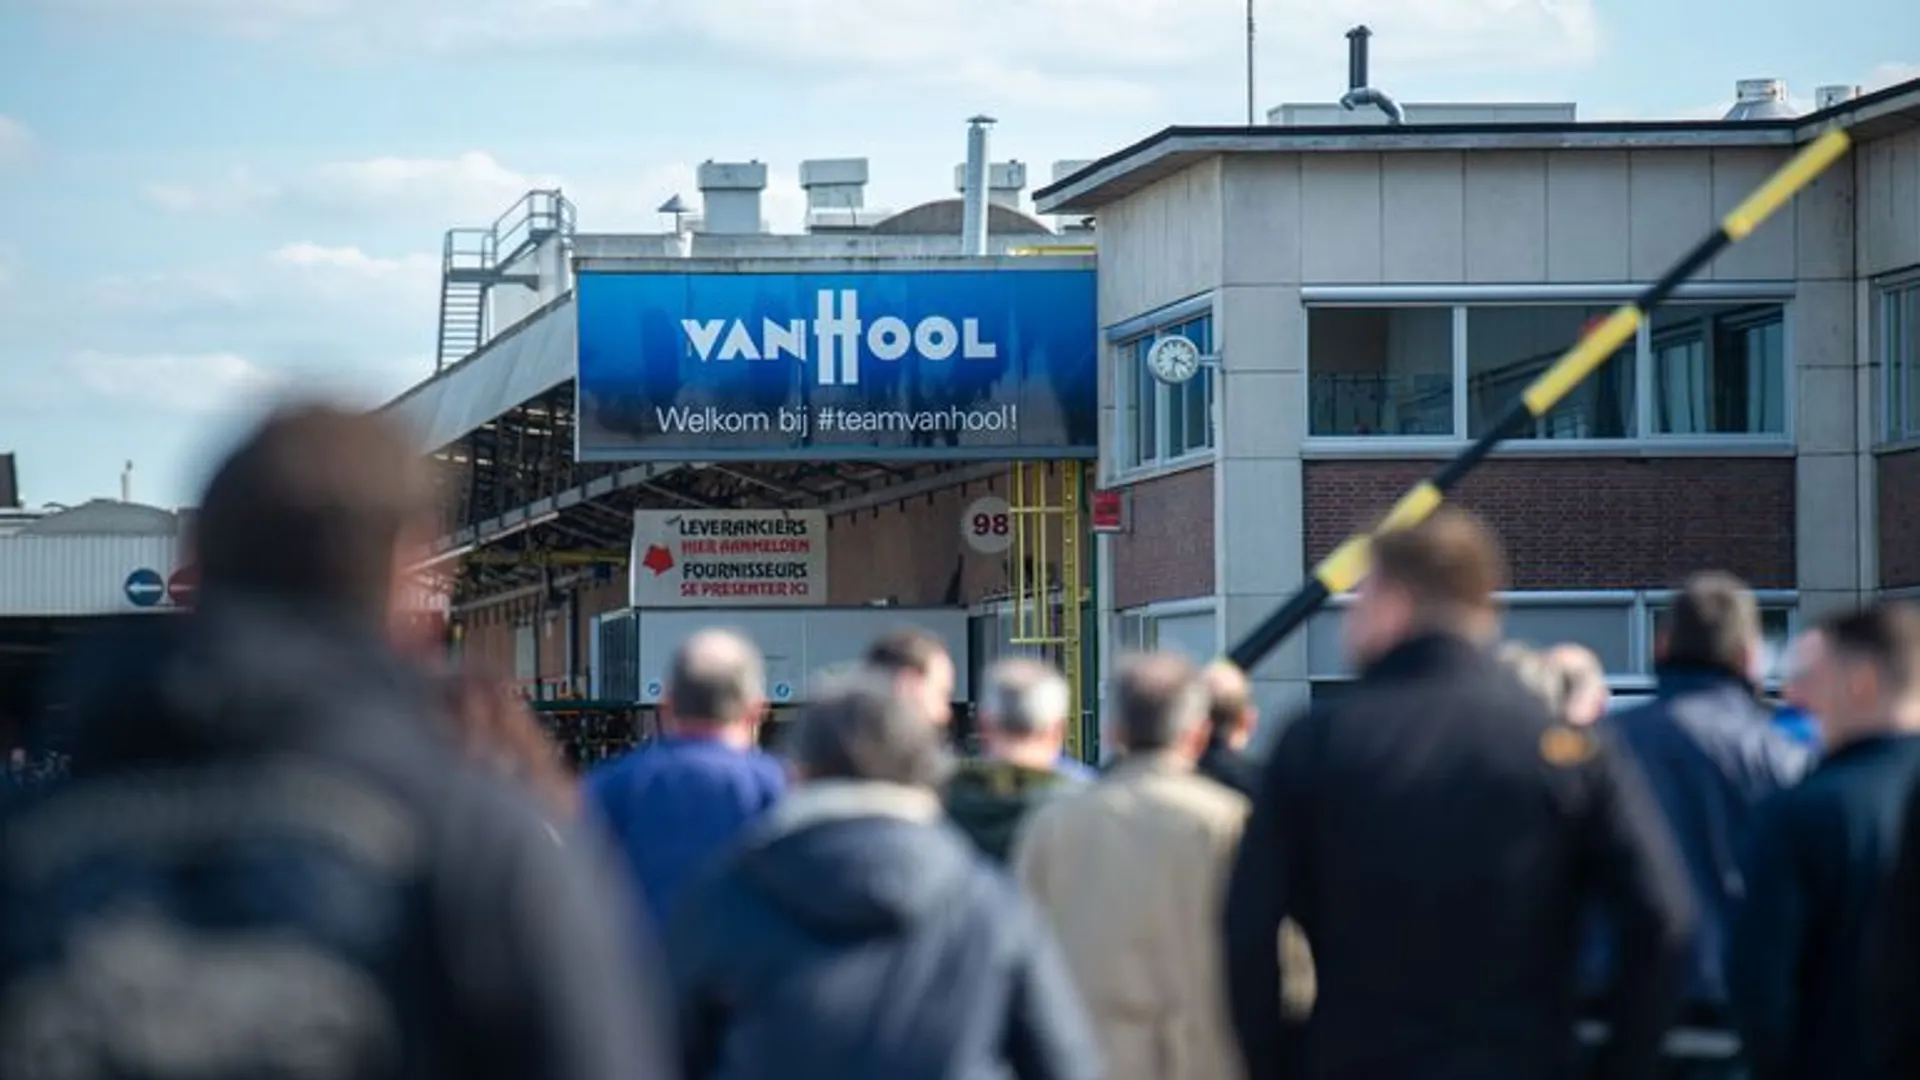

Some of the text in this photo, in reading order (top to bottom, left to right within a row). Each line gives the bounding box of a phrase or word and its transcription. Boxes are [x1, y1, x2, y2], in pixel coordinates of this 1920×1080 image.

[656, 405, 1017, 436] Welkom bij #teamvanhool!
[679, 518, 807, 536] LEVERANCIERS
[973, 514, 1009, 535] 98
[680, 538, 810, 554] HIER AANMELDEN
[682, 561, 808, 580] FOURNISSEURS
[680, 582, 699, 597] SE
[700, 581, 787, 596] PRESENTER
